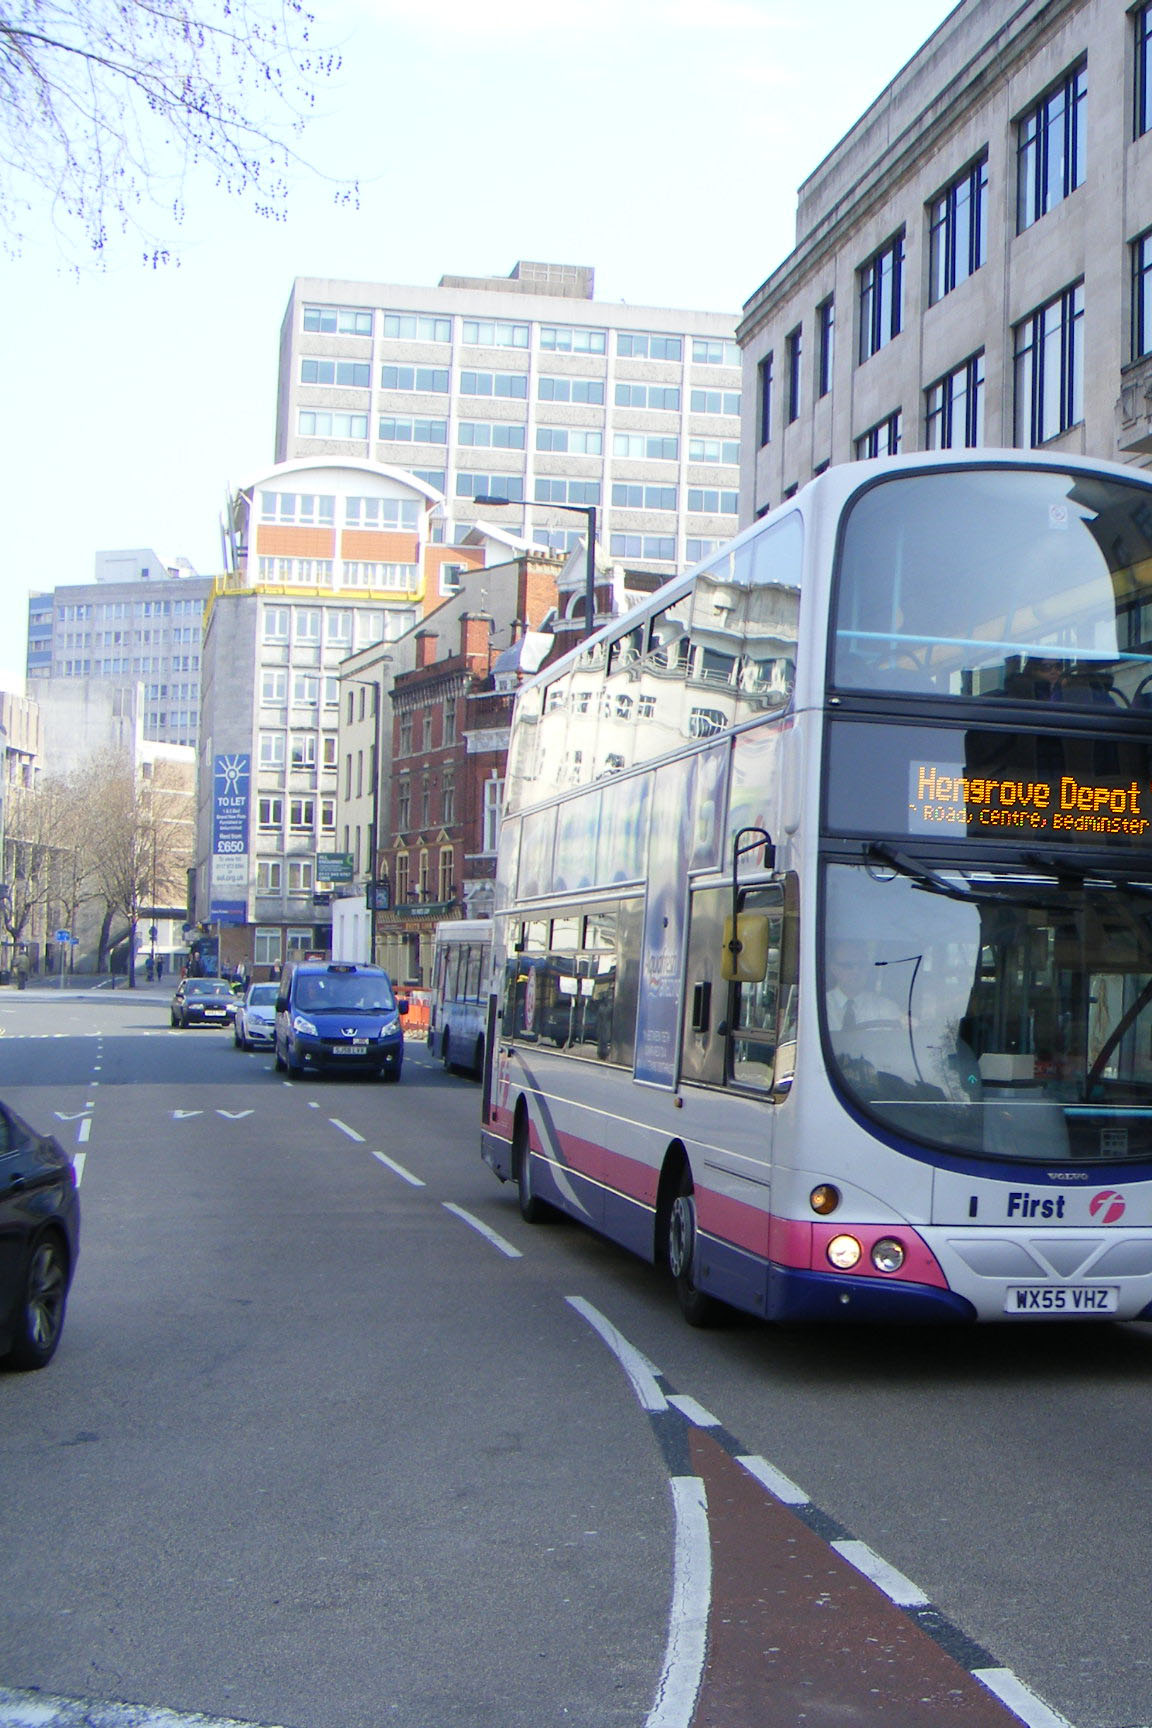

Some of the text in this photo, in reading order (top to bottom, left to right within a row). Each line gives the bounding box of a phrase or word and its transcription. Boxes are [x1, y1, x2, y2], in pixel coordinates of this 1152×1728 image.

[917, 766, 1141, 814] Hengrove Depot
[217, 797, 246, 806] TO LET
[1052, 813, 1150, 834] Bedminster
[217, 841, 244, 852] £650
[1047, 1172, 1089, 1180] VOLVO
[1007, 1192, 1066, 1218] First
[1016, 1290, 1108, 1309] WX55 VHZ
